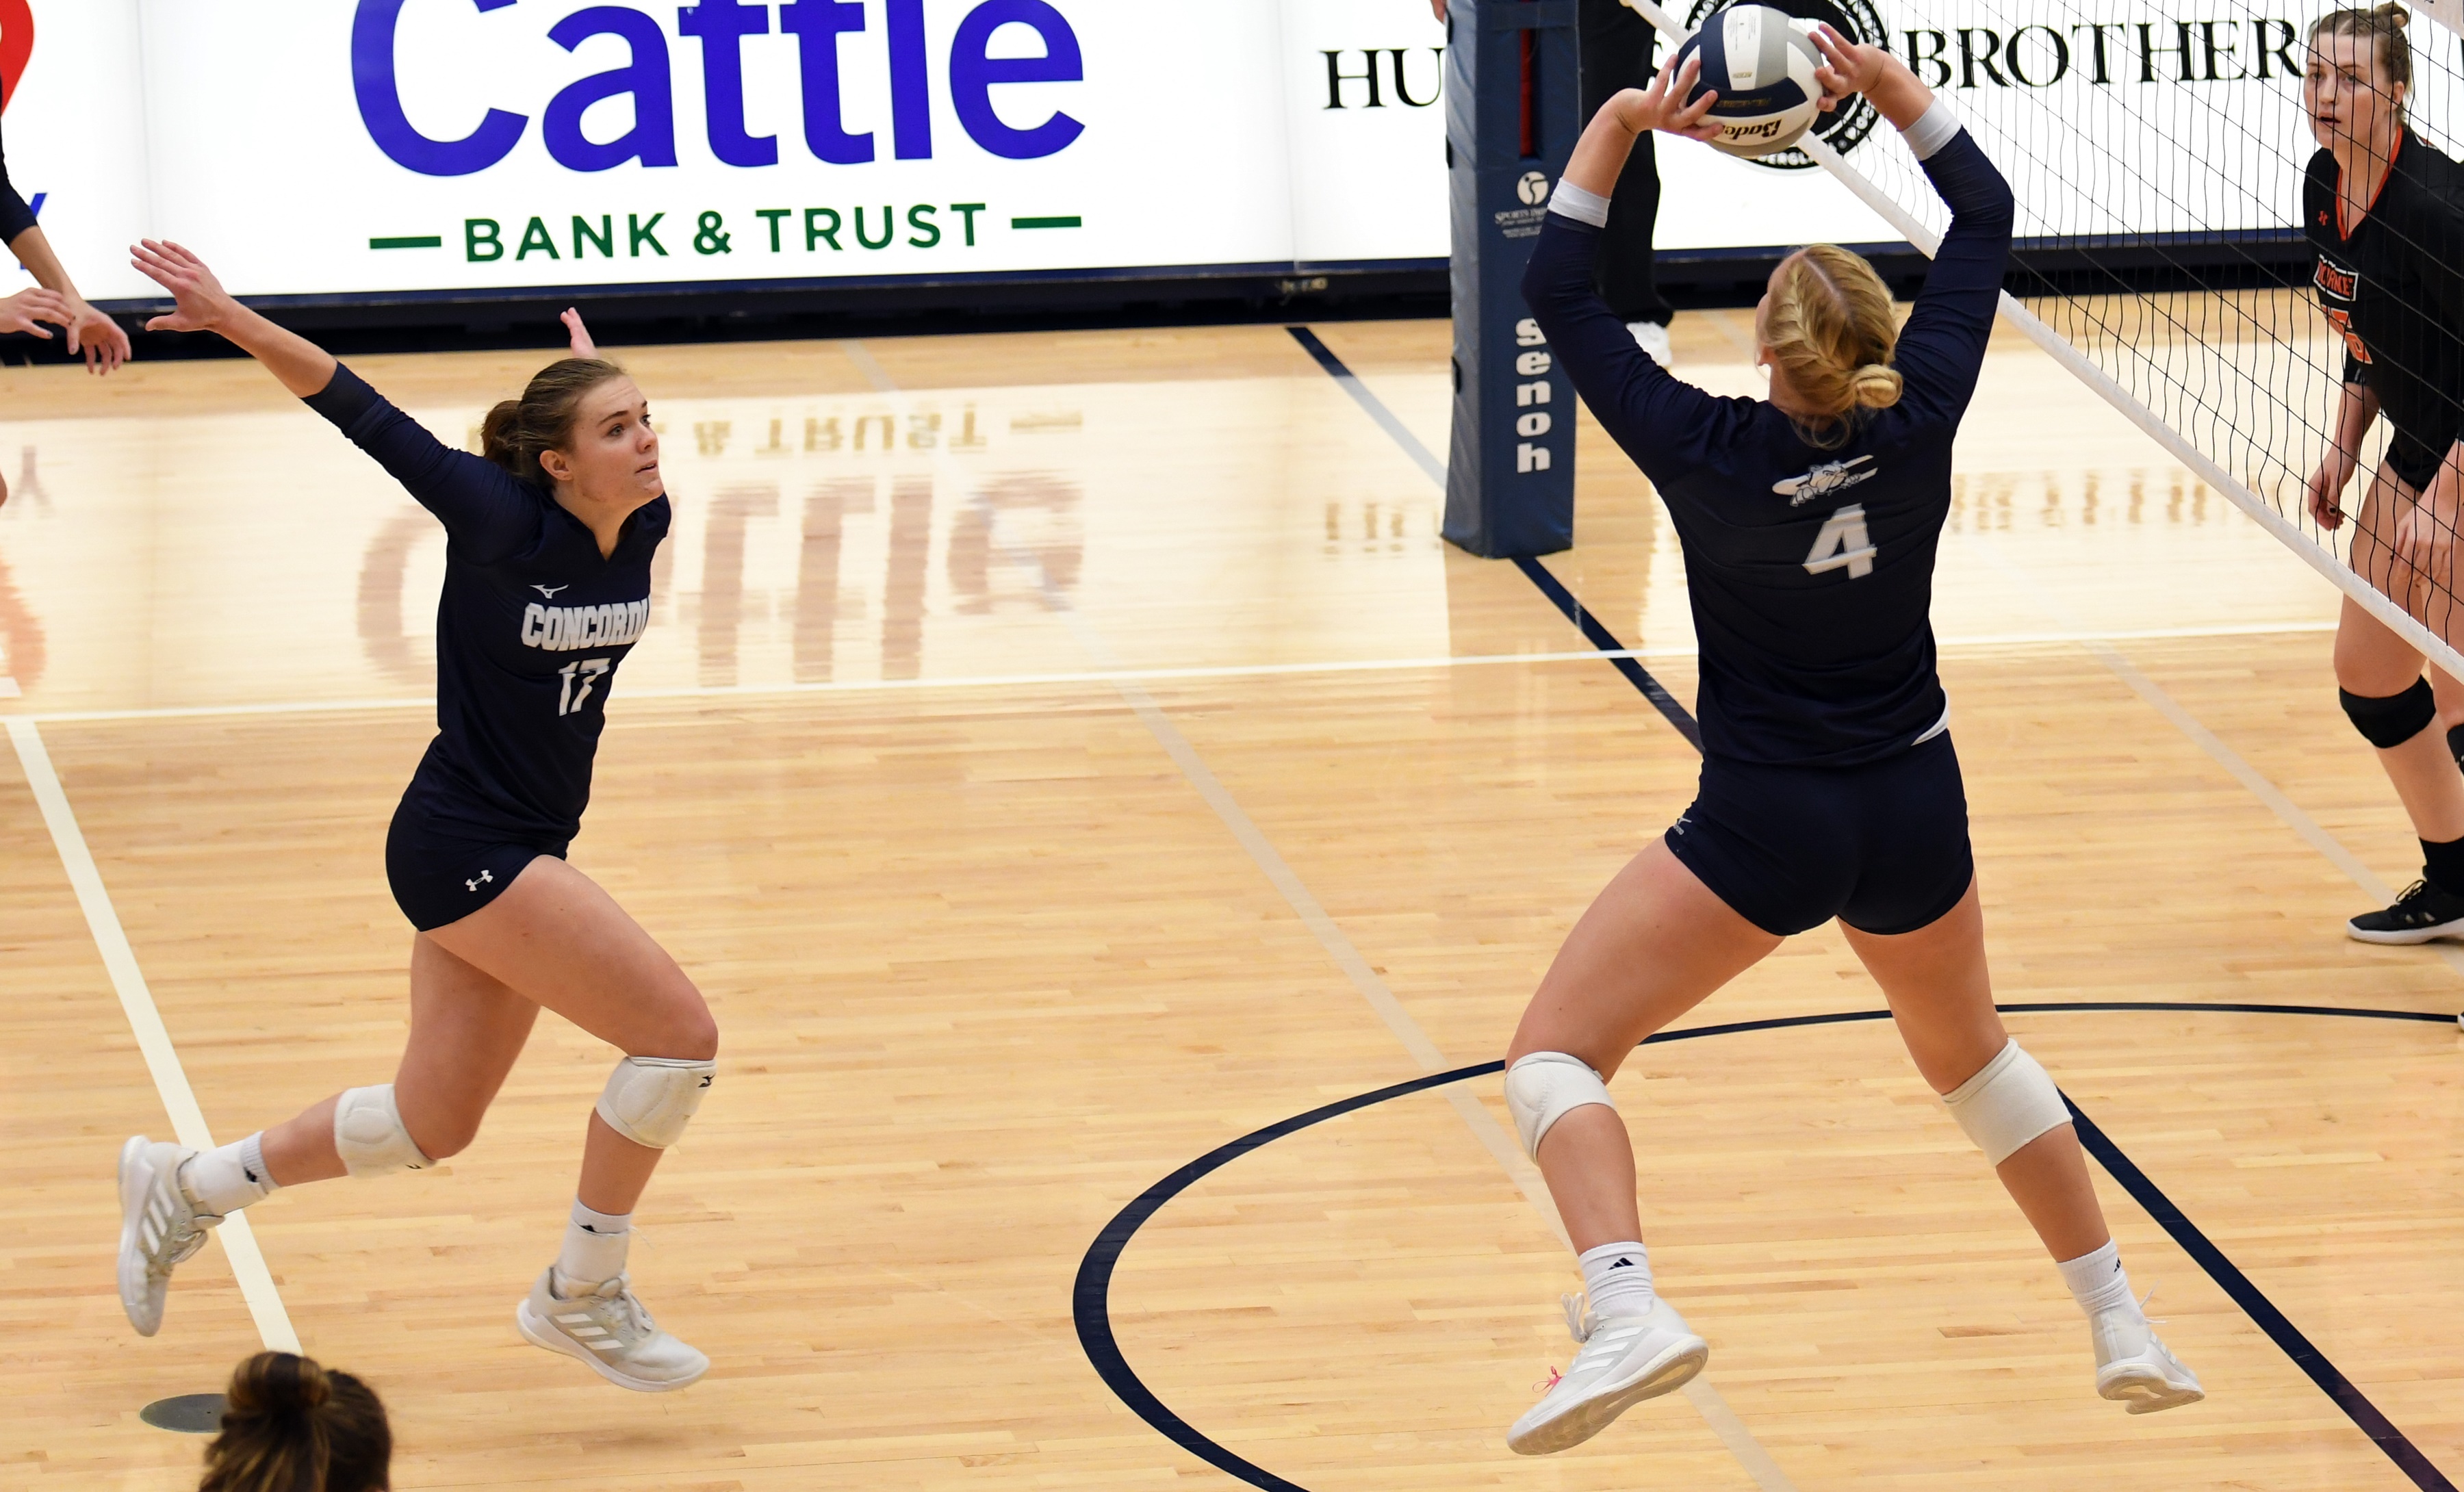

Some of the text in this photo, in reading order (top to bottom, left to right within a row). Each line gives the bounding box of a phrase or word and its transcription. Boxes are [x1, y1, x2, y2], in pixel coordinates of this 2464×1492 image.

[351, 0, 1086, 177] Cattle
[1722, 119, 1782, 140] Bade
[465, 203, 986, 262] BANK & TRUST
[1515, 317, 1552, 474] senoh
[1801, 502, 1878, 580] 4
[521, 594, 651, 652] CONCORDI
[558, 657, 612, 717] 17
